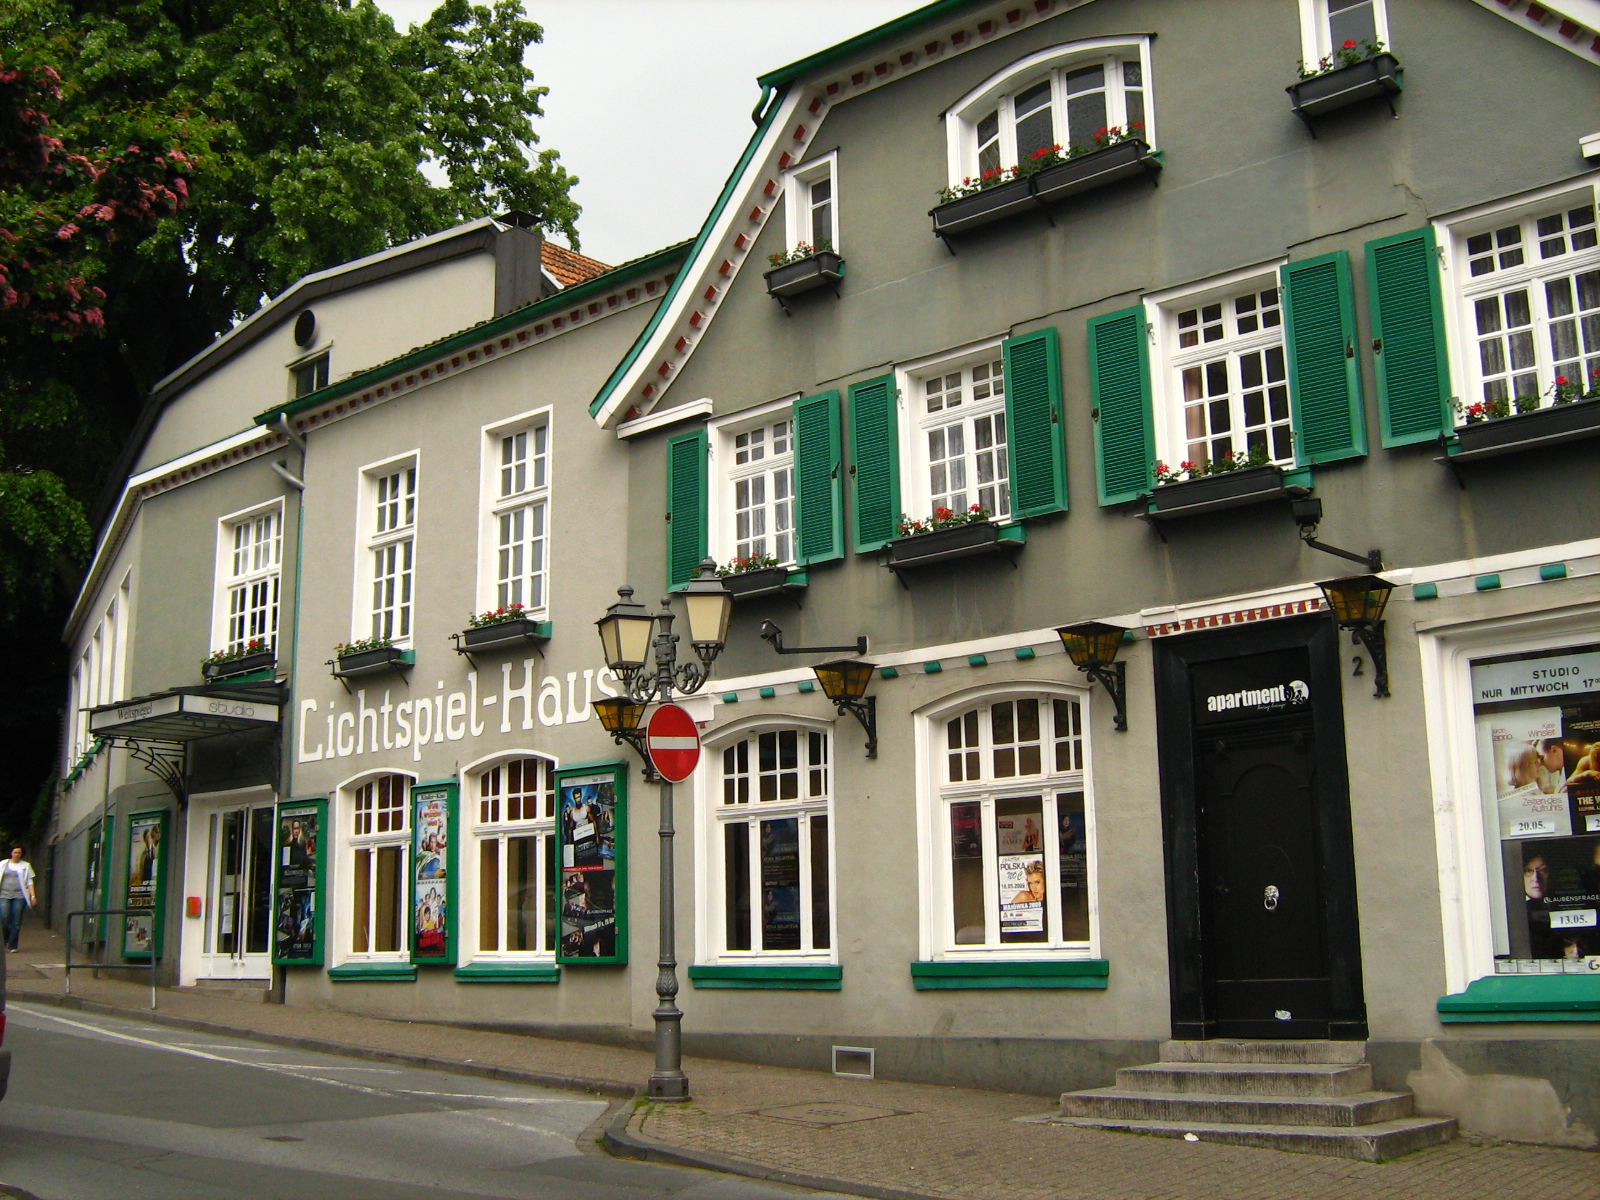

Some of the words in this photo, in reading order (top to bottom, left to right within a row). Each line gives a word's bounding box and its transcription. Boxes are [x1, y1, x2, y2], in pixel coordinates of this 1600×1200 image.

[1352, 656, 1364, 676] 2
[1532, 666, 1580, 680] STUDIO
[1207, 684, 1287, 712] apartment
[1481, 688, 1503, 699] NUR
[1510, 681, 1569, 696] MITTWOCH
[117, 702, 153, 720] Weltspiegel
[208, 701, 255, 717] studio
[298, 658, 620, 764] Lichtspiel-Haus
[1577, 796, 1594, 805] THE
[1519, 821, 1546, 831] 20.05.
[1559, 915, 1588, 925] 13.05.
